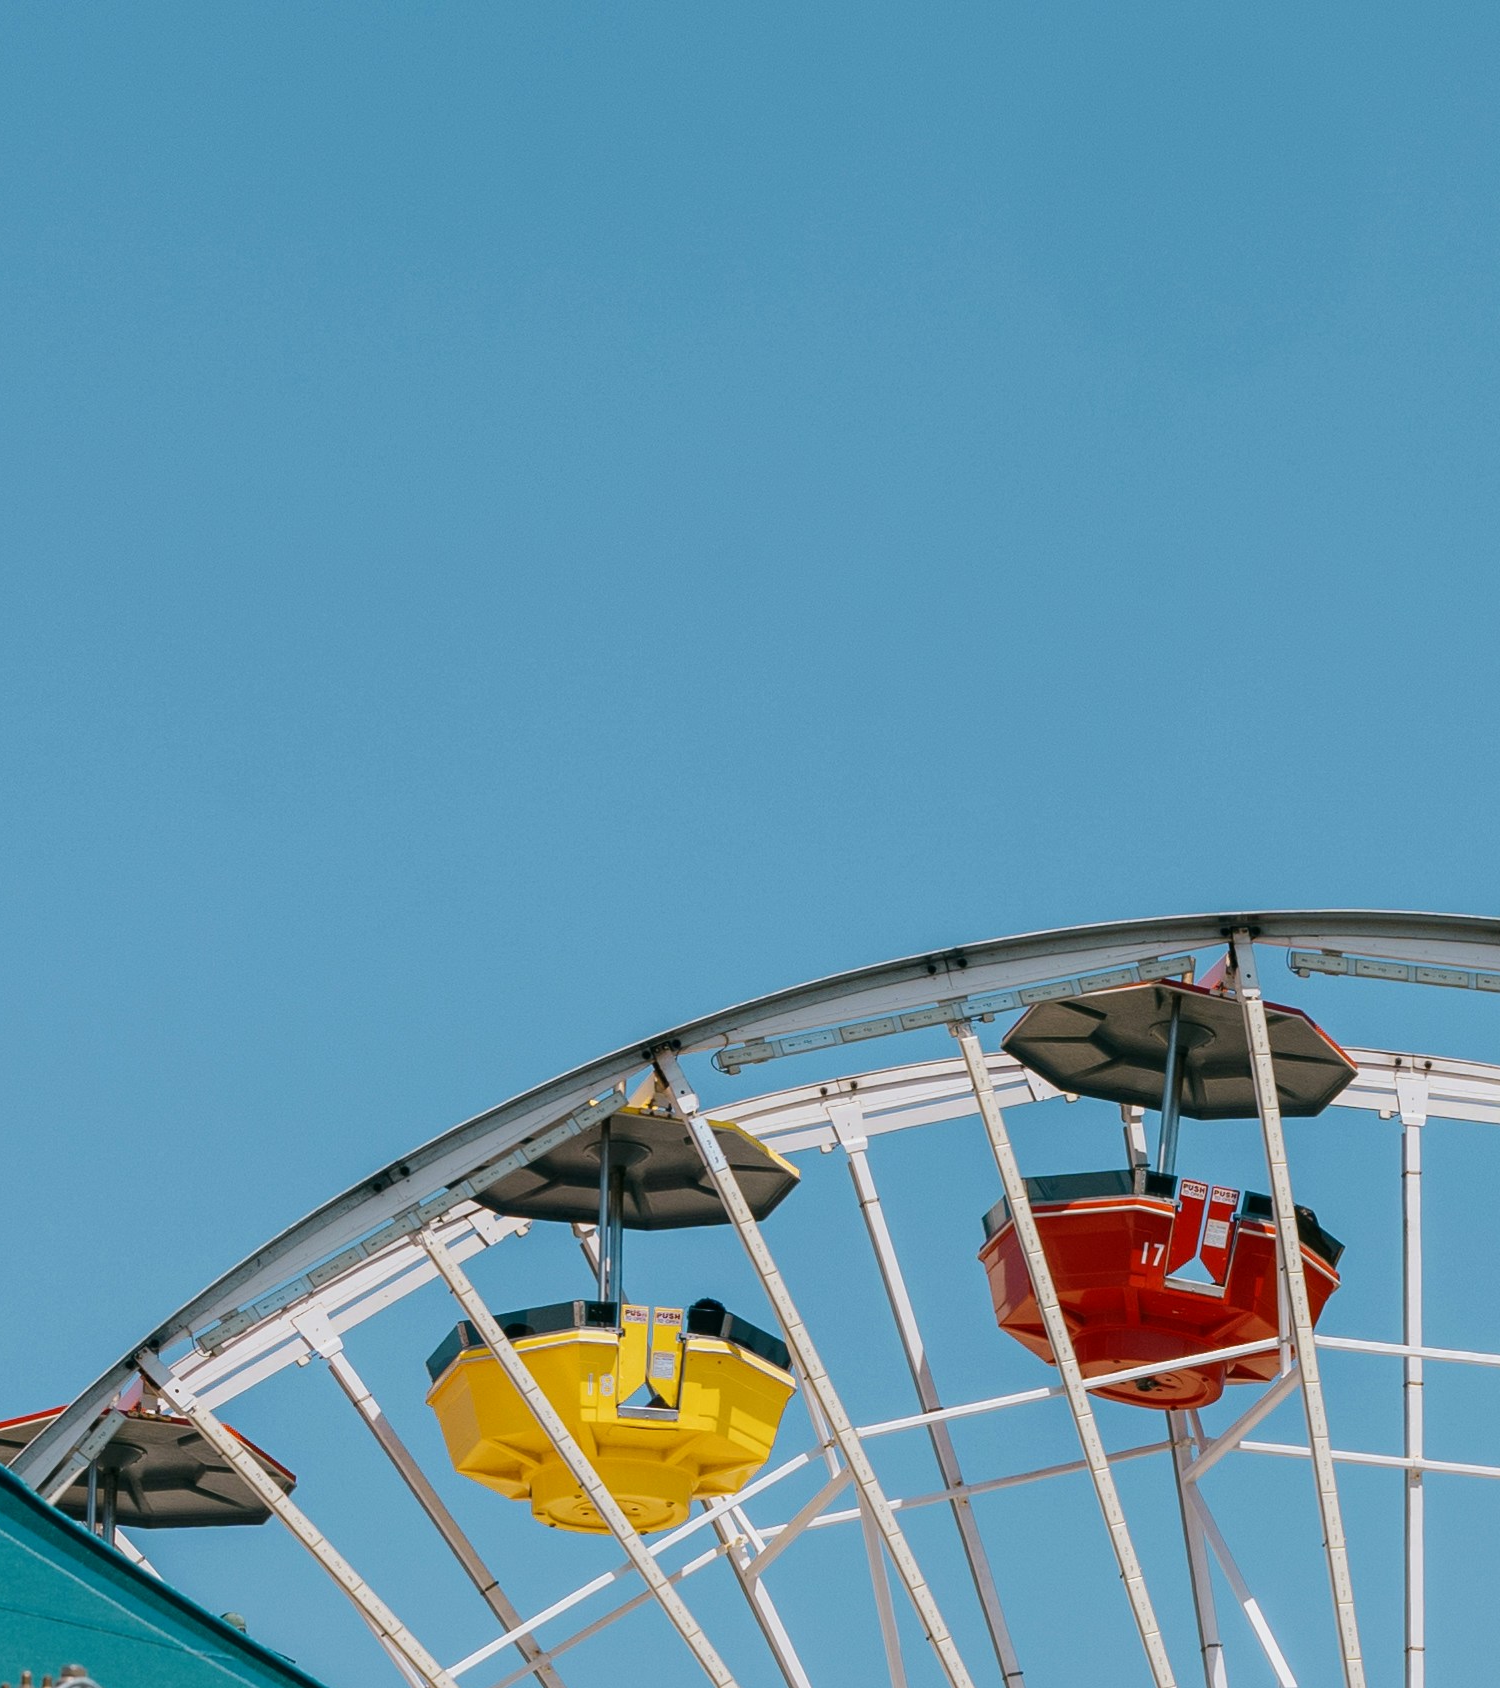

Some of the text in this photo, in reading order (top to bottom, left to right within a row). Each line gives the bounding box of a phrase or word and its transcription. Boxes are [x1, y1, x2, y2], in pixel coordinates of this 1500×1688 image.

[1183, 1183, 1206, 1194] PUSH
[1214, 1189, 1237, 1199] PUSH
[1141, 1241, 1165, 1267] 17
[656, 1312, 681, 1320] PUSH
[587, 1373, 615, 1397] 18
